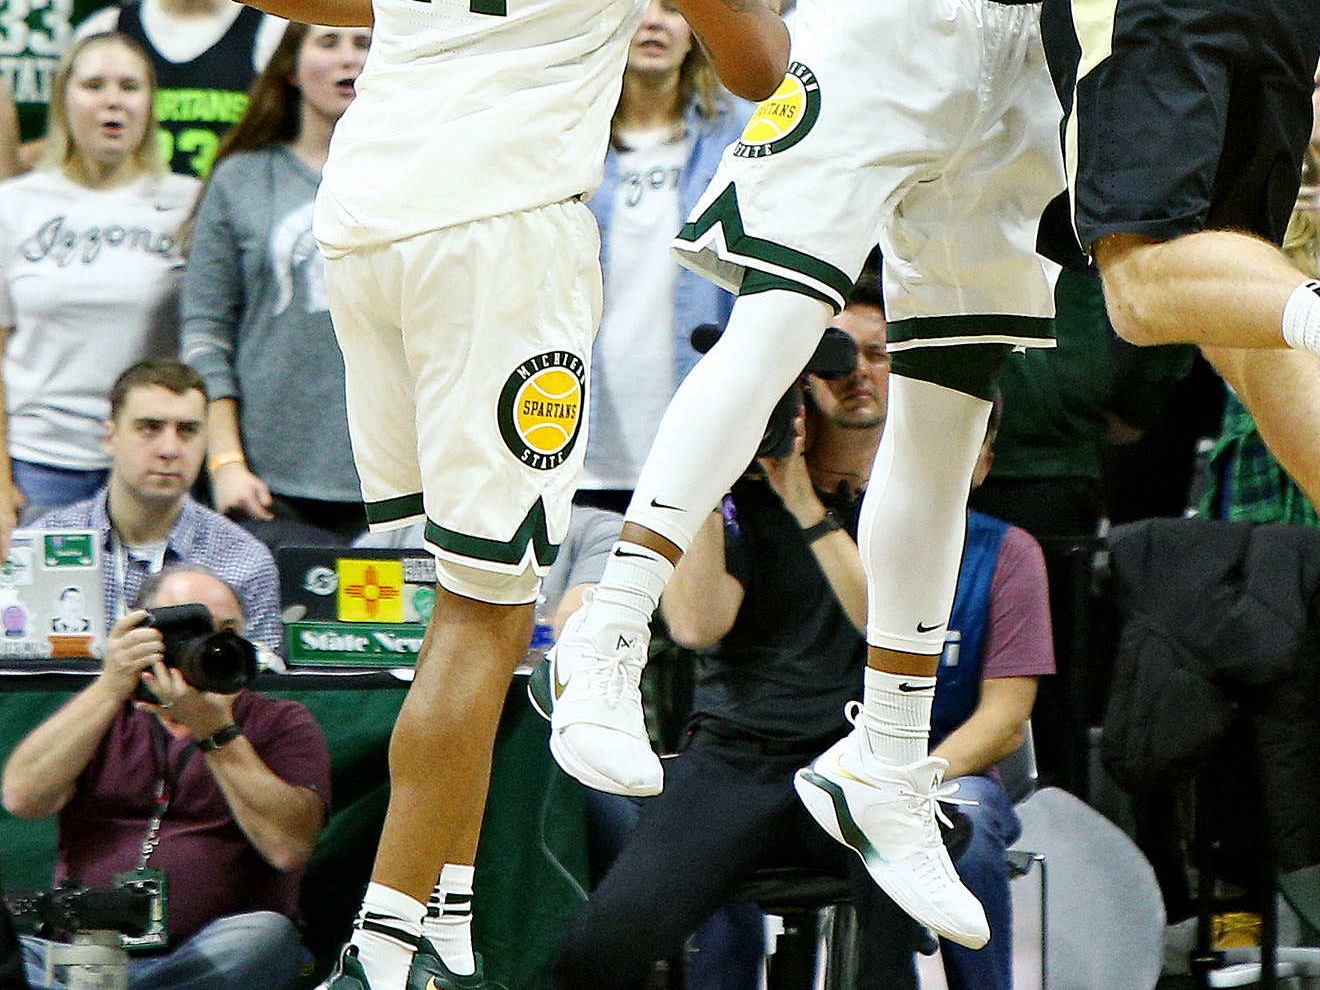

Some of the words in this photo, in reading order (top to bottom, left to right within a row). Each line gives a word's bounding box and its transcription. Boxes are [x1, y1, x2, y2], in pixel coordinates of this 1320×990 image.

[20, 215, 178, 269] Izzone
[522, 399, 578, 420] SPARTANS
[521, 448, 564, 470] STATE
[300, 630, 371, 653] State
